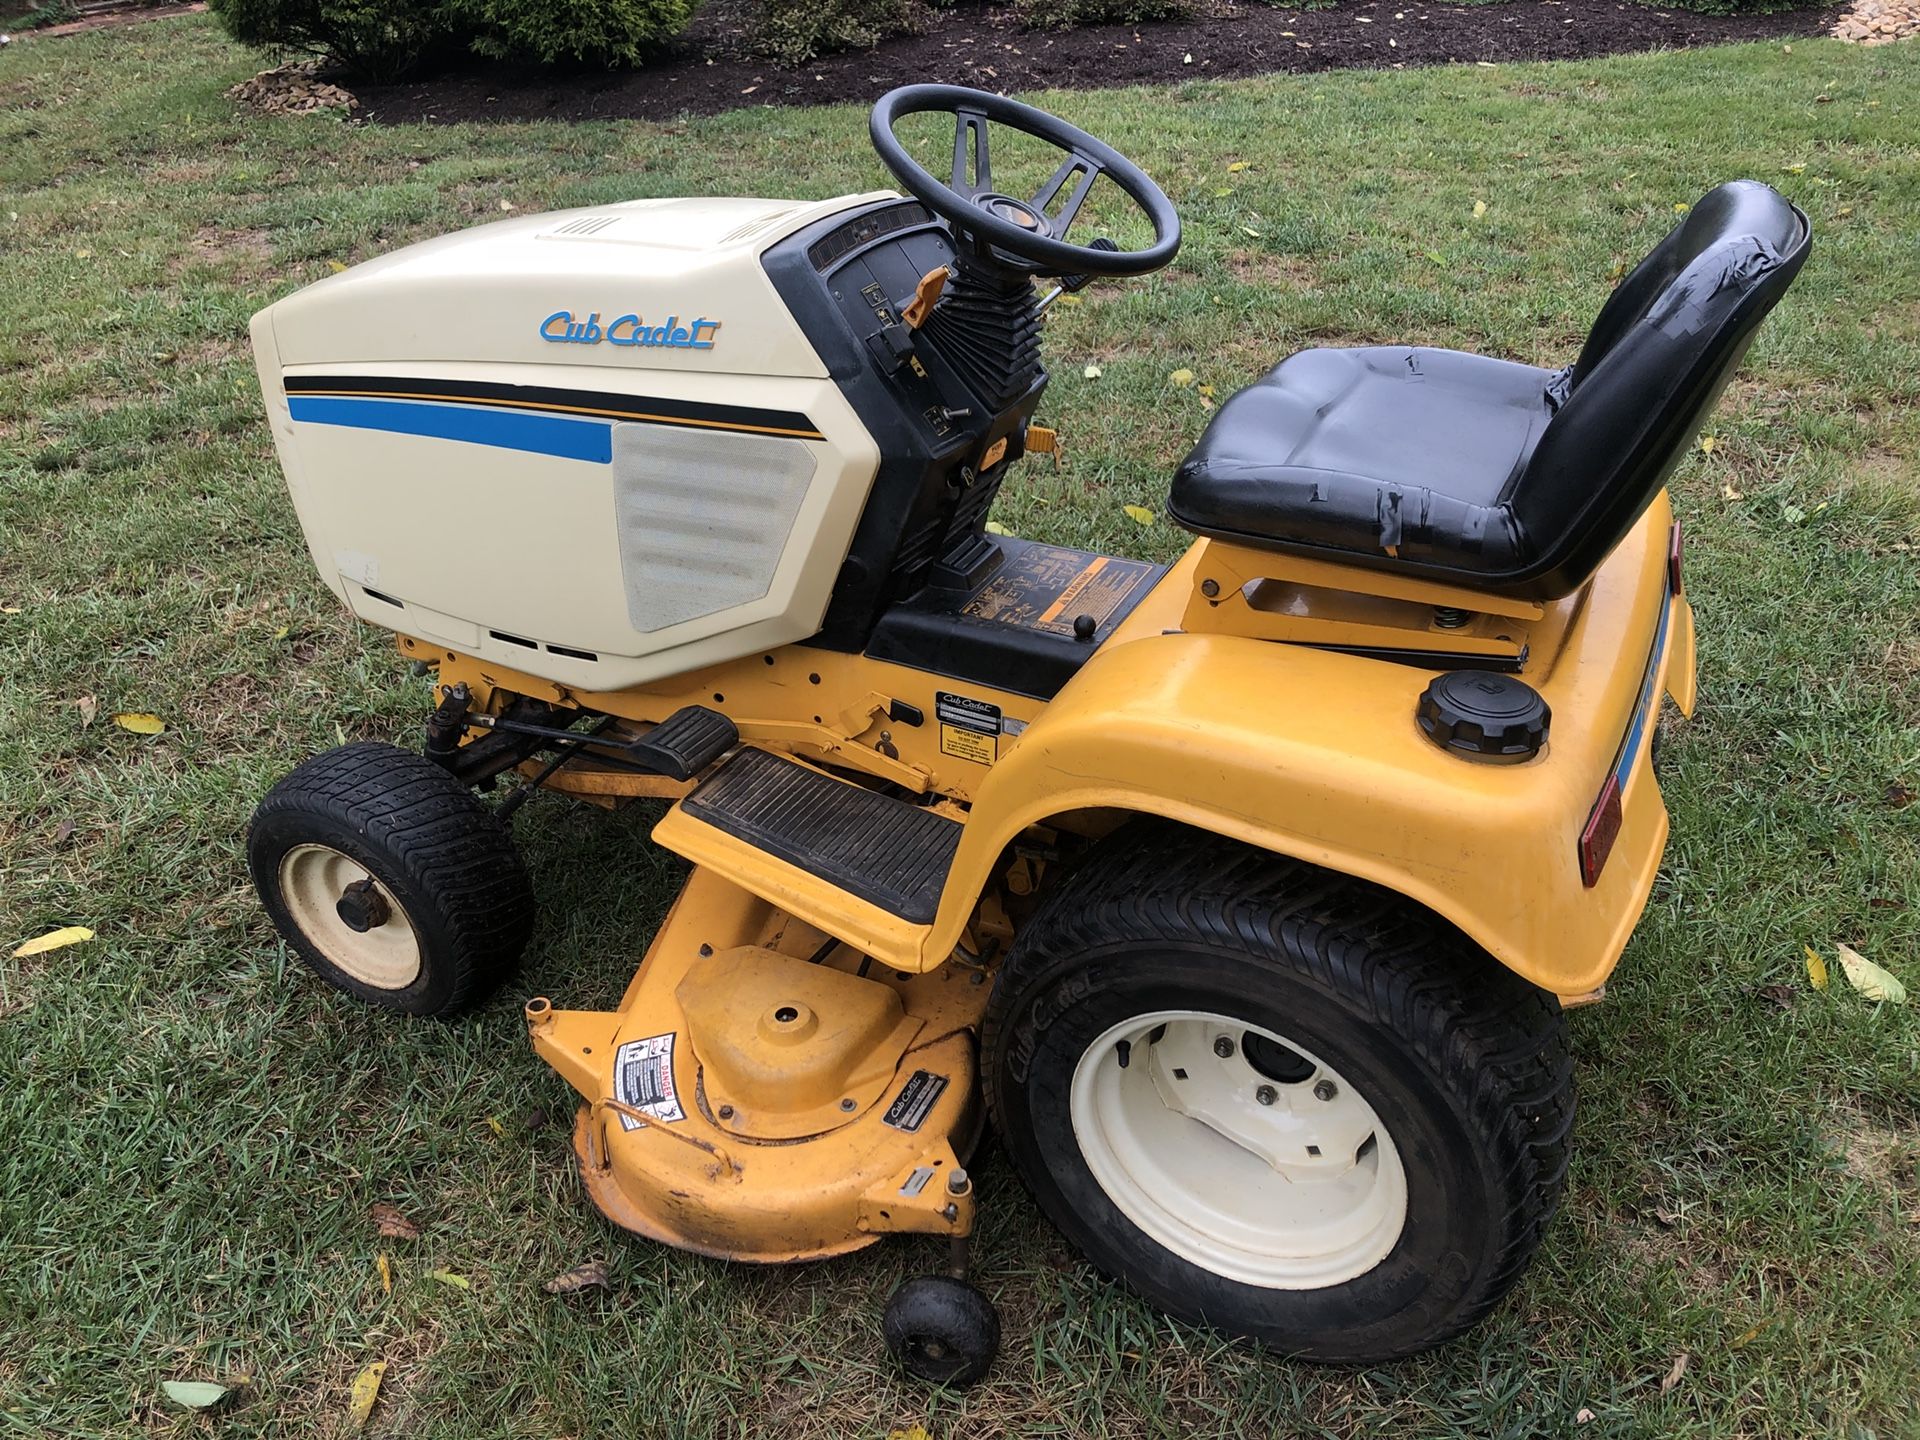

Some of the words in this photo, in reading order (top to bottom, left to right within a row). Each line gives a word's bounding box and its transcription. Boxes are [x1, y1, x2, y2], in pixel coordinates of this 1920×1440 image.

[539, 310, 602, 345] Cub
[606, 313, 722, 349] Cadet
[1066, 572, 1094, 603] WARNING
[943, 694, 961, 705] Cub
[961, 699, 992, 713] Cadet
[953, 728, 984, 741] IMPORTANT
[661, 1064, 673, 1097] DANGER
[891, 1101, 905, 1118] Cub
[902, 1076, 921, 1102] Cadet
